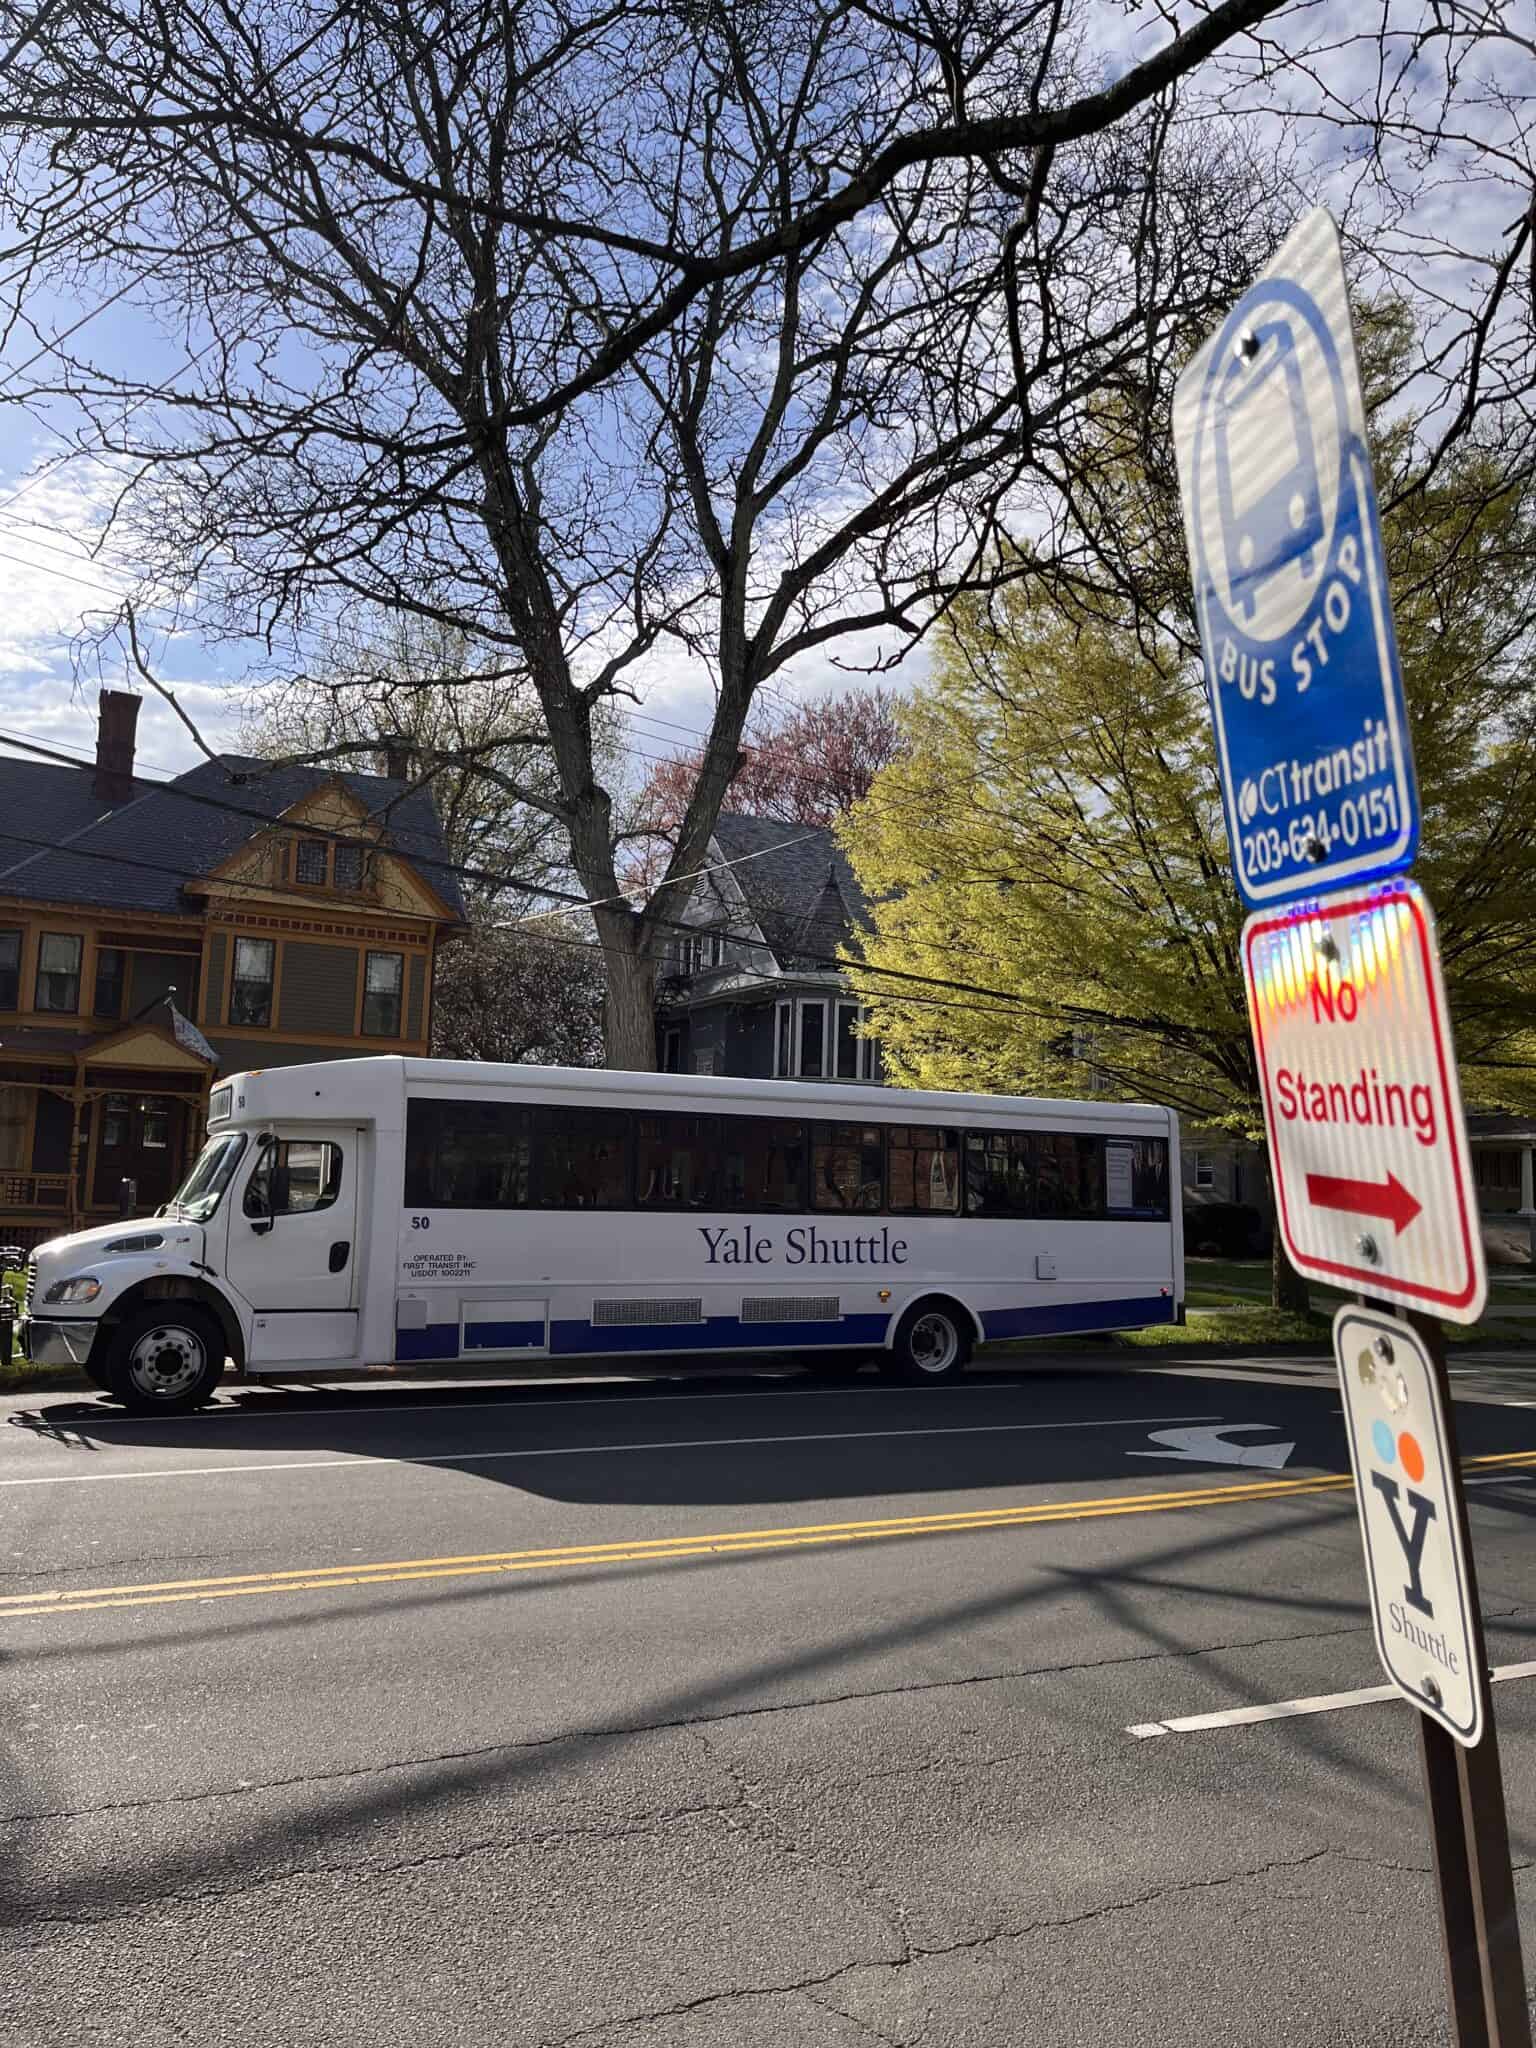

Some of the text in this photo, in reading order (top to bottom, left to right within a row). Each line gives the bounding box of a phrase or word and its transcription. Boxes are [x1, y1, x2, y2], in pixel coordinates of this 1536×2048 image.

[1219, 533, 1362, 706] BUS STOP
[1309, 969, 1358, 1025] No
[1276, 1067, 1438, 1147] Standing
[411, 1216, 430, 1230] 50
[697, 1225, 909, 1265] Yale Shuttle
[413, 1254, 466, 1262] OPERATED BY
[429, 1261, 460, 1269] TRANSIT
[463, 1261, 477, 1269] INC
[1371, 1468, 1438, 1620] Y
[1388, 1601, 1460, 1675] Shuttle
